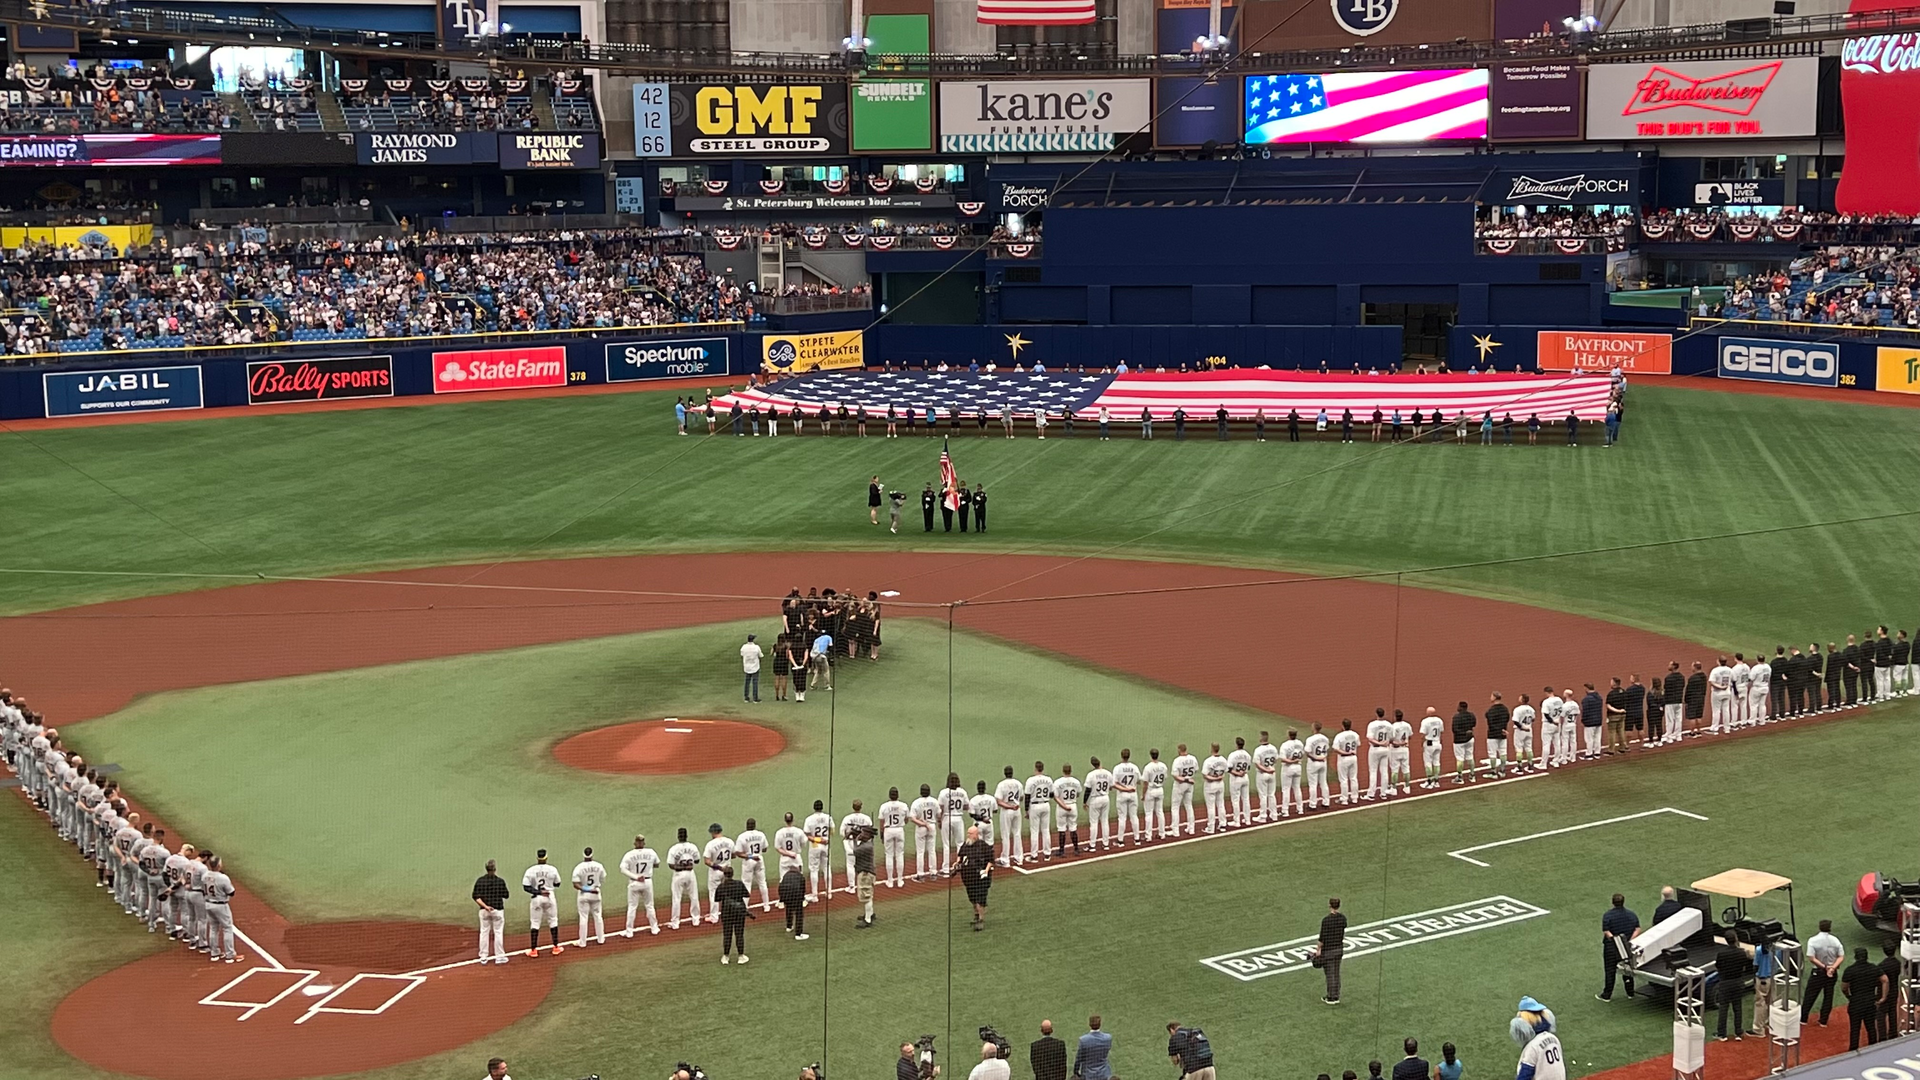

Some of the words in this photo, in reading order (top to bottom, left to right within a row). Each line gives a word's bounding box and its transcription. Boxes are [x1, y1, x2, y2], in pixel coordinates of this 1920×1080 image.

[641, 87, 663, 105] 42
[1637, 79, 1764, 103] Budweiser
[977, 84, 1112, 121] kane's
[696, 86, 822, 135] GMF
[644, 111, 661, 129] 12
[990, 125, 1100, 134] FURNITURE
[1636, 122, 1664, 135] THIS
[1707, 120, 1730, 134] FOR
[371, 134, 457, 148] RAYMOND
[516, 135, 584, 149] REPUBLIC
[642, 136, 664, 153] 66
[701, 141, 756, 150] STEEL
[763, 140, 820, 150] GROUP
[371, 148, 427, 163] JAMES
[530, 148, 571, 161] BANK
[1003, 185, 1047, 195] Budweiser
[1513, 180, 1577, 194] Budweiser
[1576, 179, 1629, 192] PORCH
[1734, 182, 1759, 190] BLACK
[1734, 189, 1755, 197] LIVES
[736, 198, 751, 208] St.
[754, 198, 813, 208] Petersburg
[816, 197, 865, 207] Welcomes
[868, 197, 891, 206] You!
[1002, 194, 1048, 206] PORCH
[1734, 196, 1763, 204] MATTER
[1565, 336, 1646, 353] BAYFRONT
[625, 345, 704, 368] Spectrum
[800, 345, 860, 359] CLEARWATER
[1574, 352, 1635, 368] HEALTH
[1723, 345, 1835, 378] GEICO
[251, 363, 330, 399] Bally
[331, 369, 389, 389] SPORTS
[570, 371, 587, 381] 378
[1840, 374, 1856, 385] 382
[79, 373, 170, 393] JABIL
[115, 400, 130, 408] OUR
[1096, 781, 1108, 792] 38
[1121, 775, 1134, 786] 47
[1036, 787, 1049, 798] 29
[1063, 789, 1076, 800] 36
[888, 814, 900, 825] 15
[814, 826, 828, 837] 22
[749, 843, 760, 854] 13
[786, 840, 793, 850] 8
[717, 850, 731, 862] 43
[635, 862, 648, 874] 17
[586, 874, 595, 886] 5
[1397, 902, 1528, 937] HEALTH
[1545, 1046, 1560, 1064] 00
